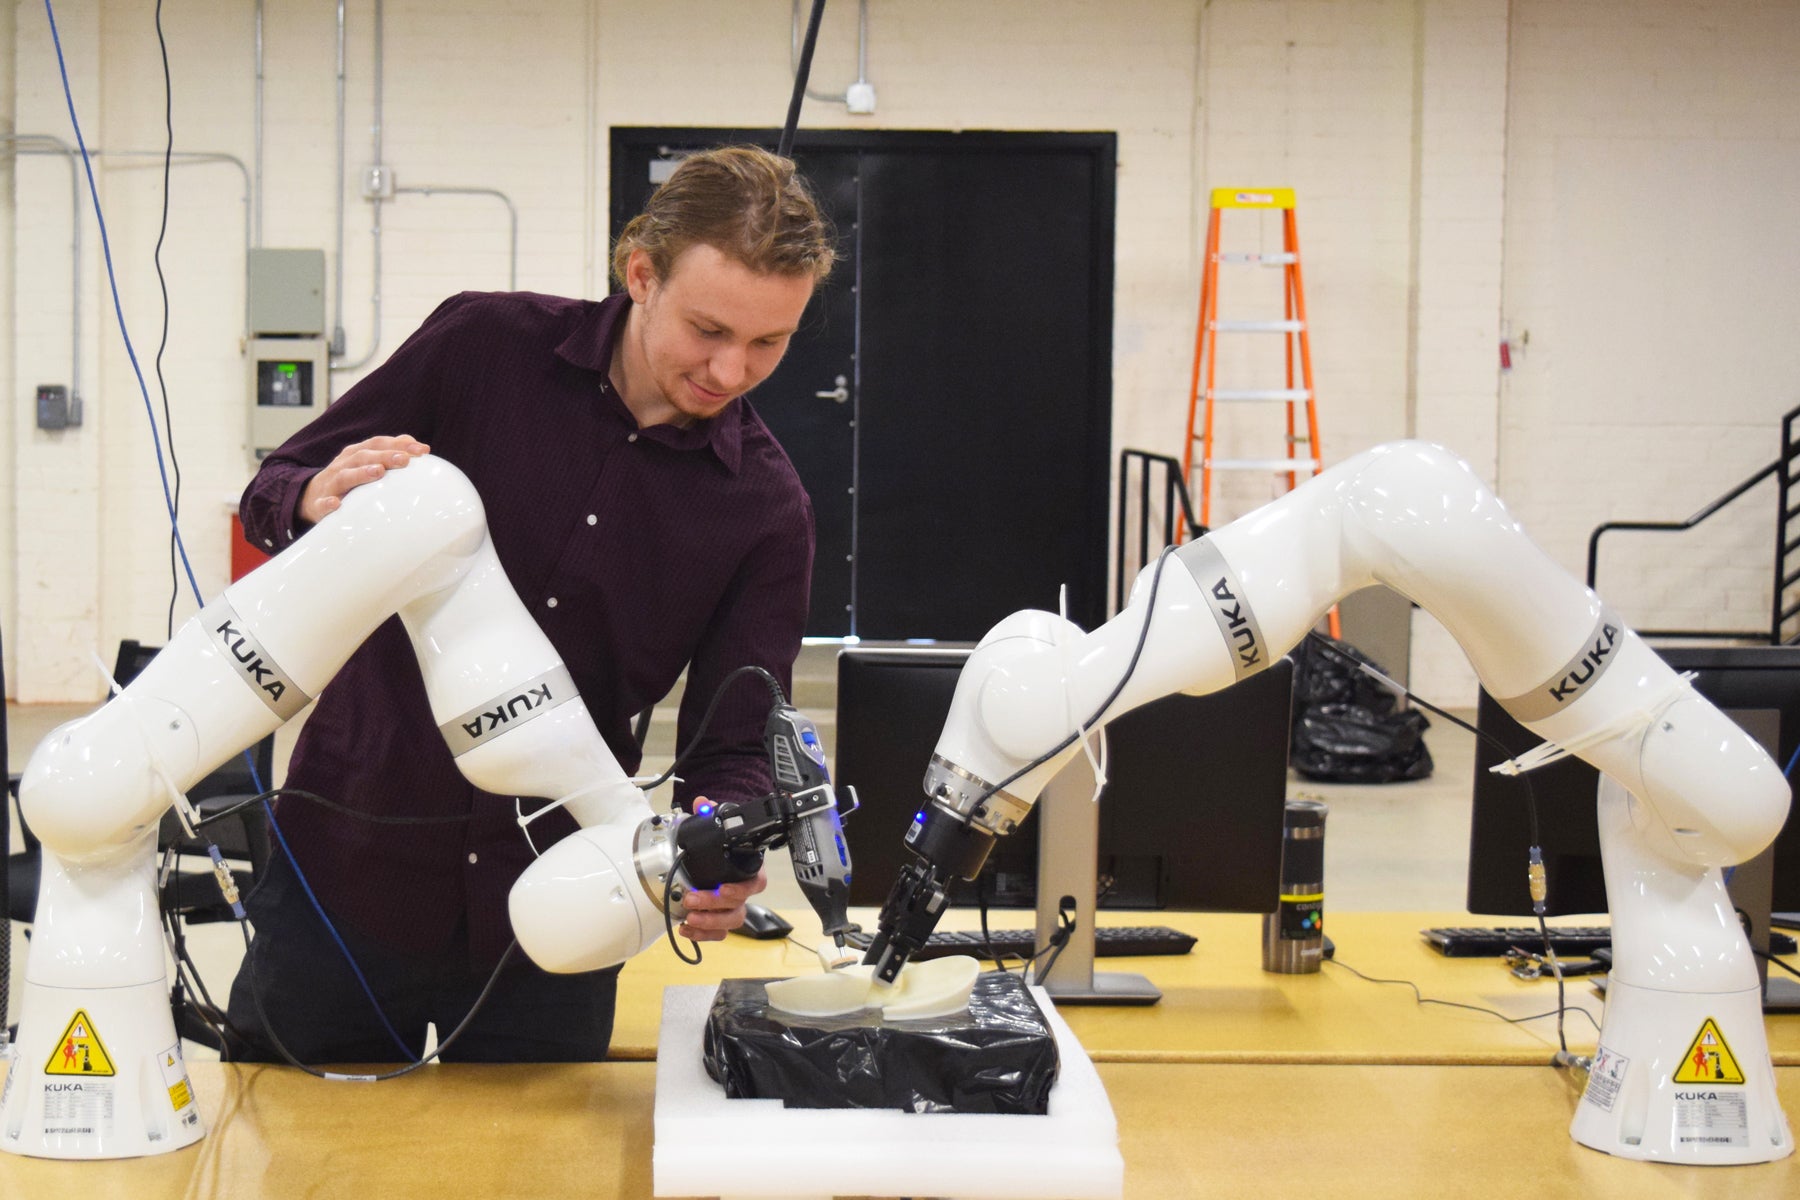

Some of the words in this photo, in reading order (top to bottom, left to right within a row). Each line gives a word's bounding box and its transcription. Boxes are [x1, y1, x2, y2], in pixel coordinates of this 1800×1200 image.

[1211, 576, 1261, 668] KUKA
[216, 620, 286, 702] KUKA
[1548, 623, 1618, 702] KUKA
[461, 683, 553, 738] KUKA
[44, 1083, 83, 1092] KUKA
[1674, 1092, 1718, 1100] KUKA
